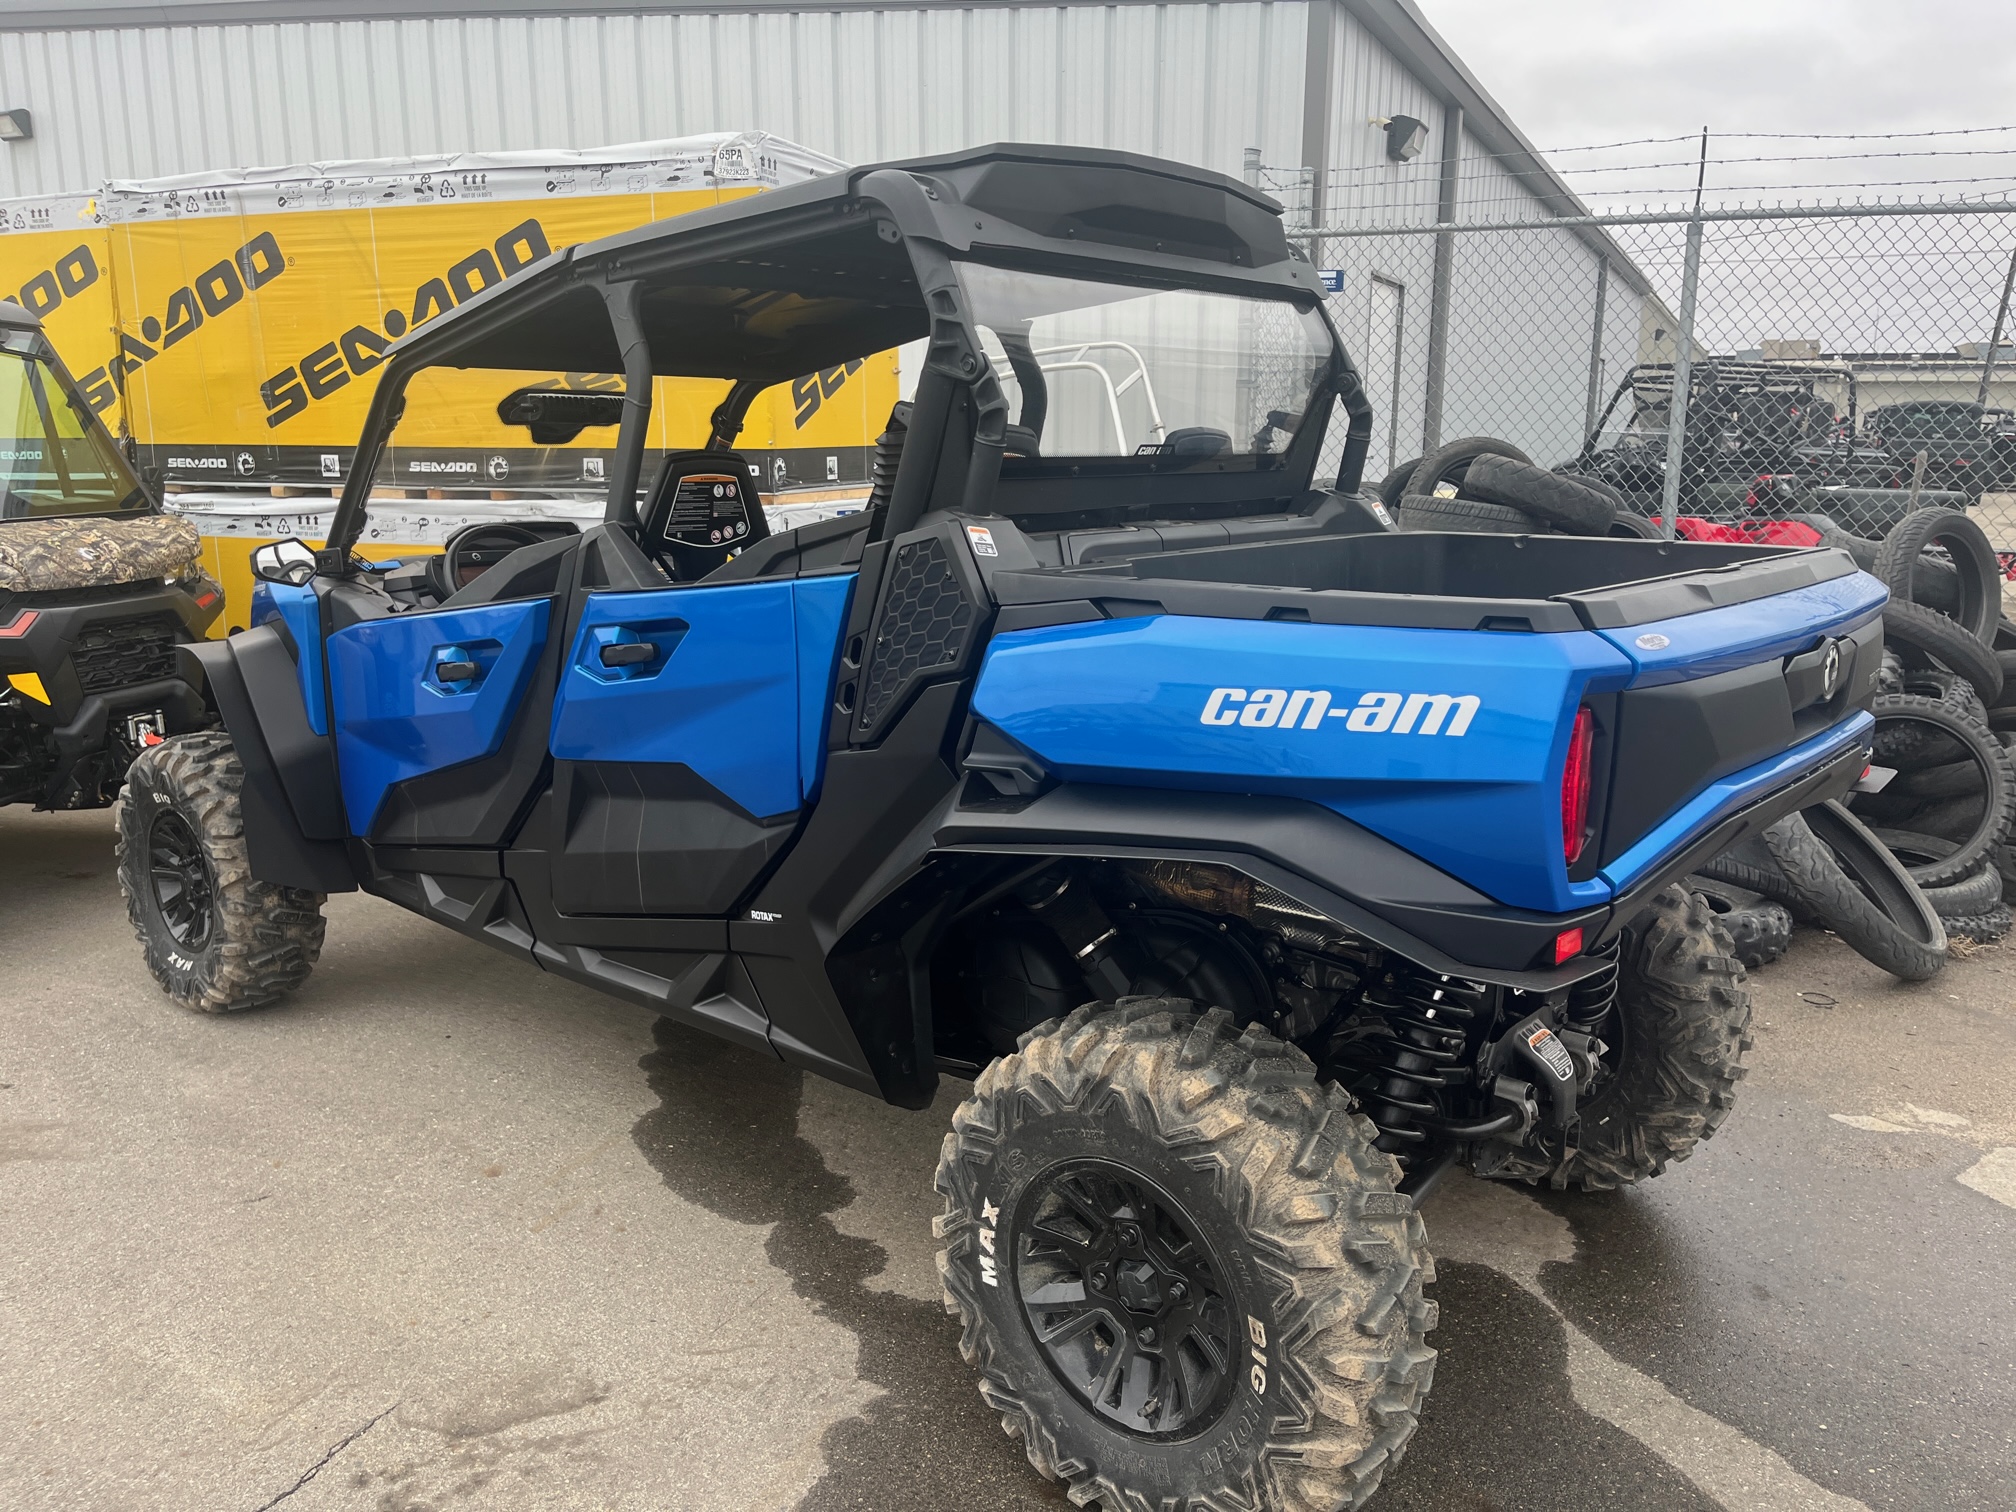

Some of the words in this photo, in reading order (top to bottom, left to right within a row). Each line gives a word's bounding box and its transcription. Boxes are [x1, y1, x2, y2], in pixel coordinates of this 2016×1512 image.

[718, 149, 743, 161] 65PA
[1200, 687, 1481, 736] can-am
[751, 910, 774, 922] ROTAX
[979, 1196, 1000, 1288] MAX
[1247, 1314, 1267, 1396] BIG
